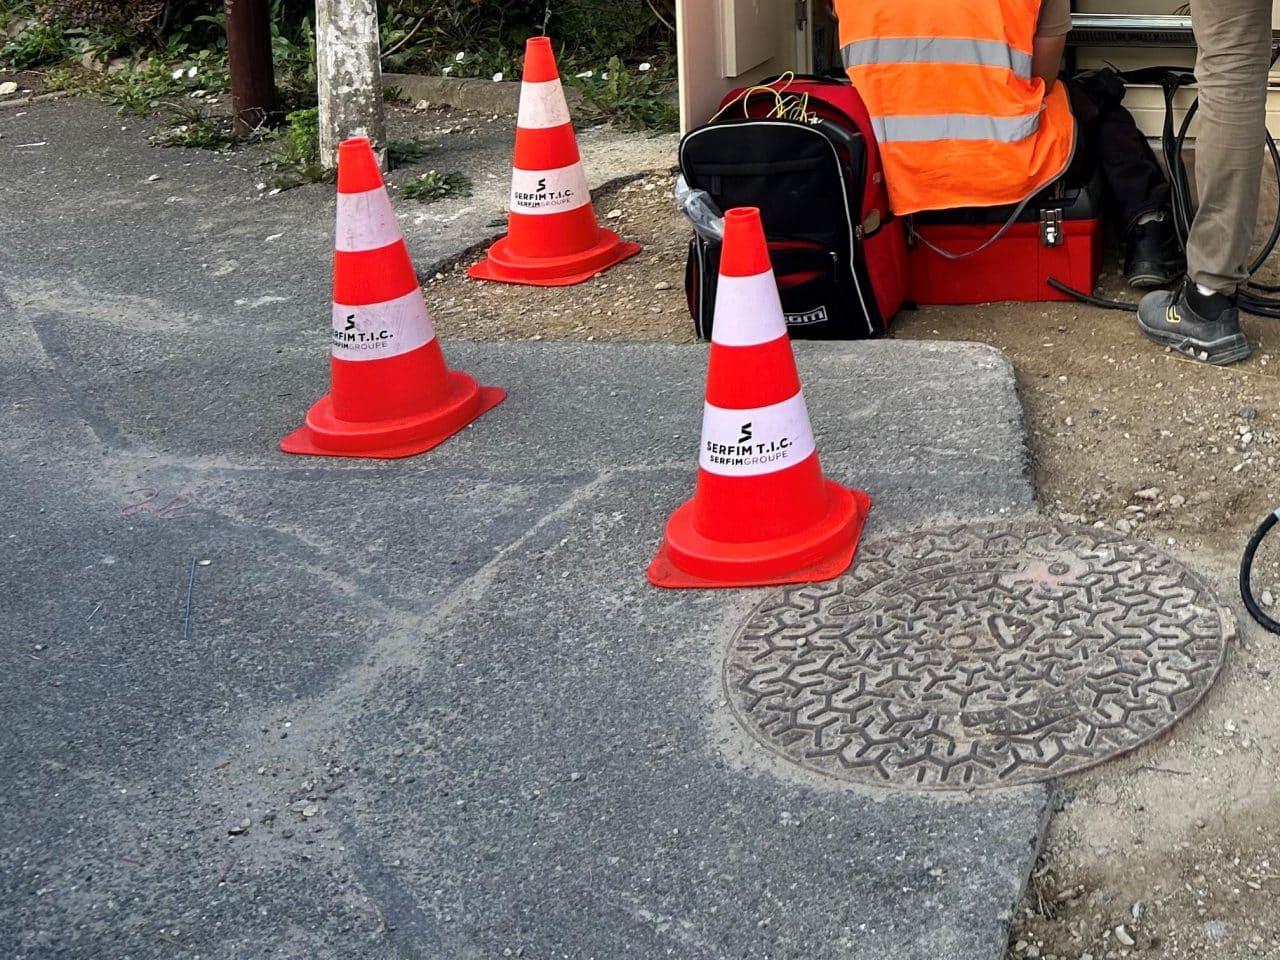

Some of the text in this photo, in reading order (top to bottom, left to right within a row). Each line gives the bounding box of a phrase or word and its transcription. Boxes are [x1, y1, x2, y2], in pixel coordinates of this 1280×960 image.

[515, 189, 574, 201] SERFIM T.I.C.
[358, 330, 394, 343] T.I.C.
[706, 437, 793, 456] SERFIM T.I.C.
[710, 450, 788, 466] SERFIMGROUPE
